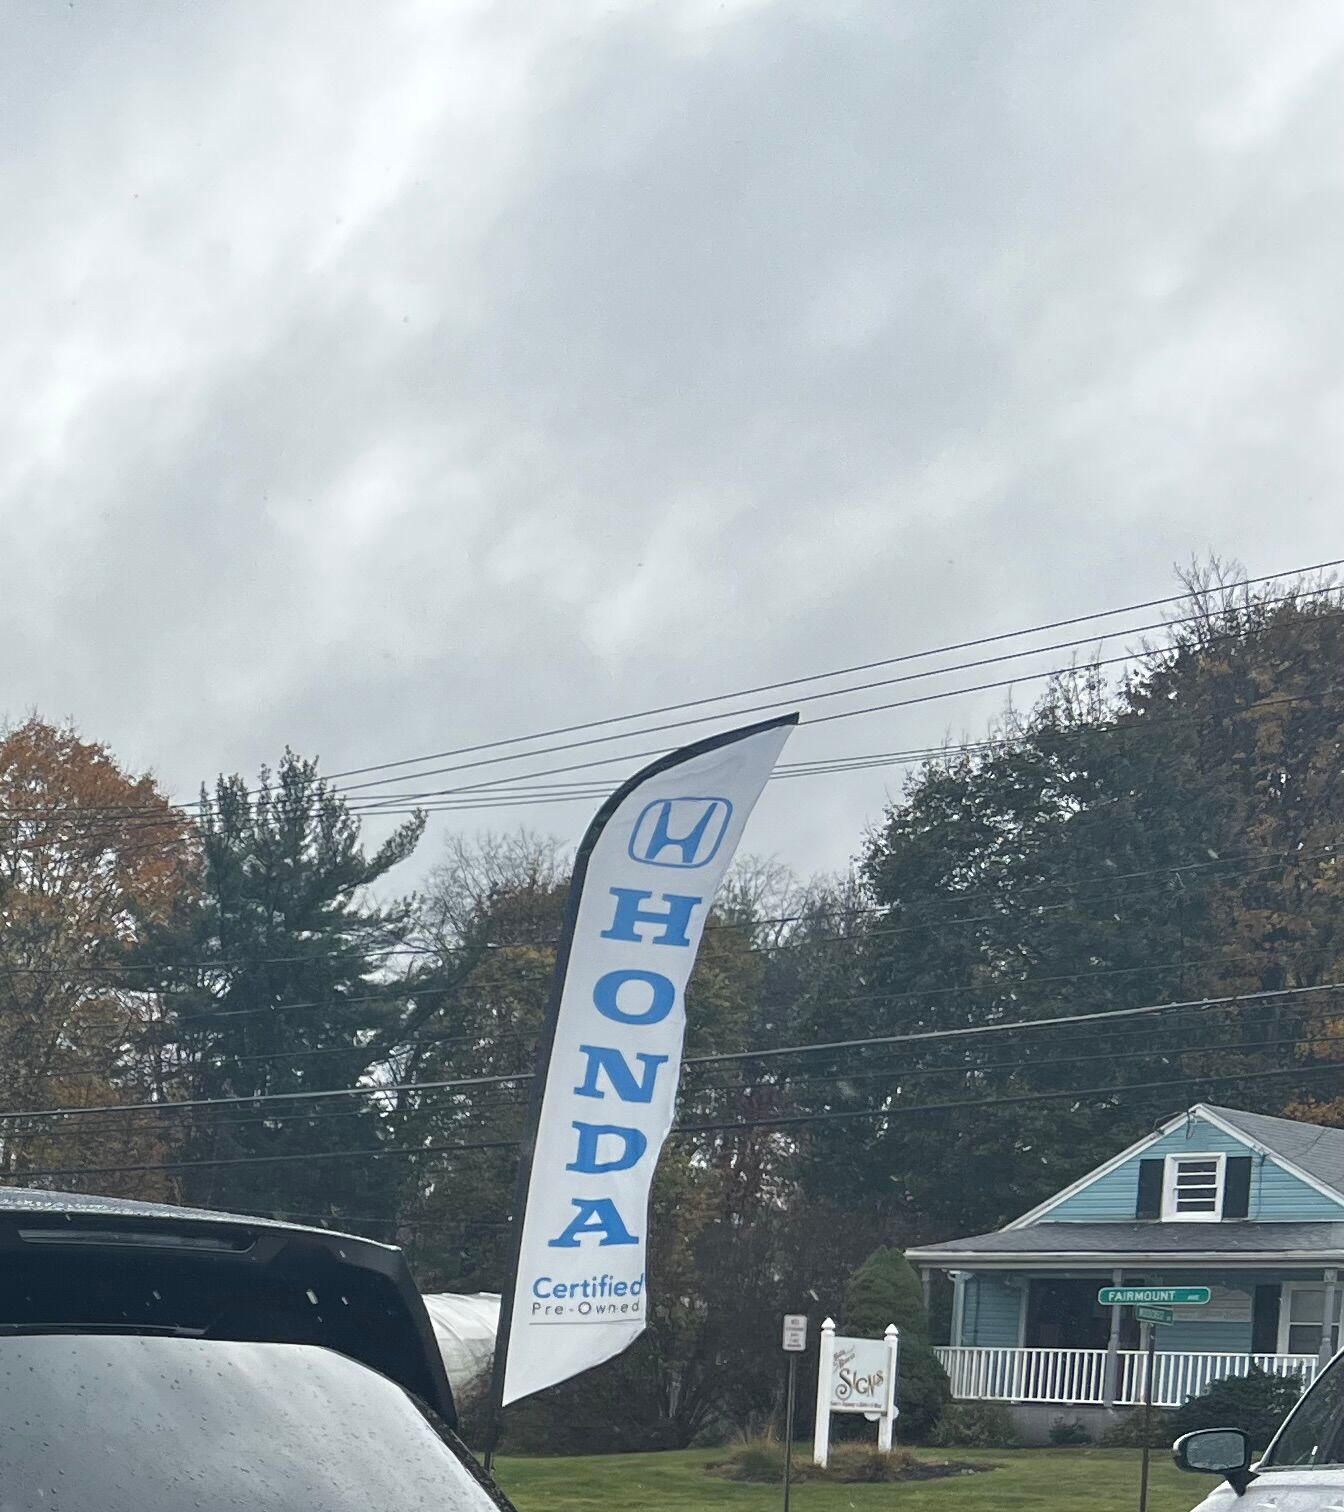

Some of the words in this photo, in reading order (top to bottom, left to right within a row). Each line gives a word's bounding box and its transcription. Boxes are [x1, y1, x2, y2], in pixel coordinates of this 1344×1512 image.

[547, 886, 703, 1249] HONDA
[532, 1272, 645, 1299] Certified
[1107, 1290, 1177, 1302] FAIRMOUNT
[531, 1299, 640, 1316] Pre-Owned
